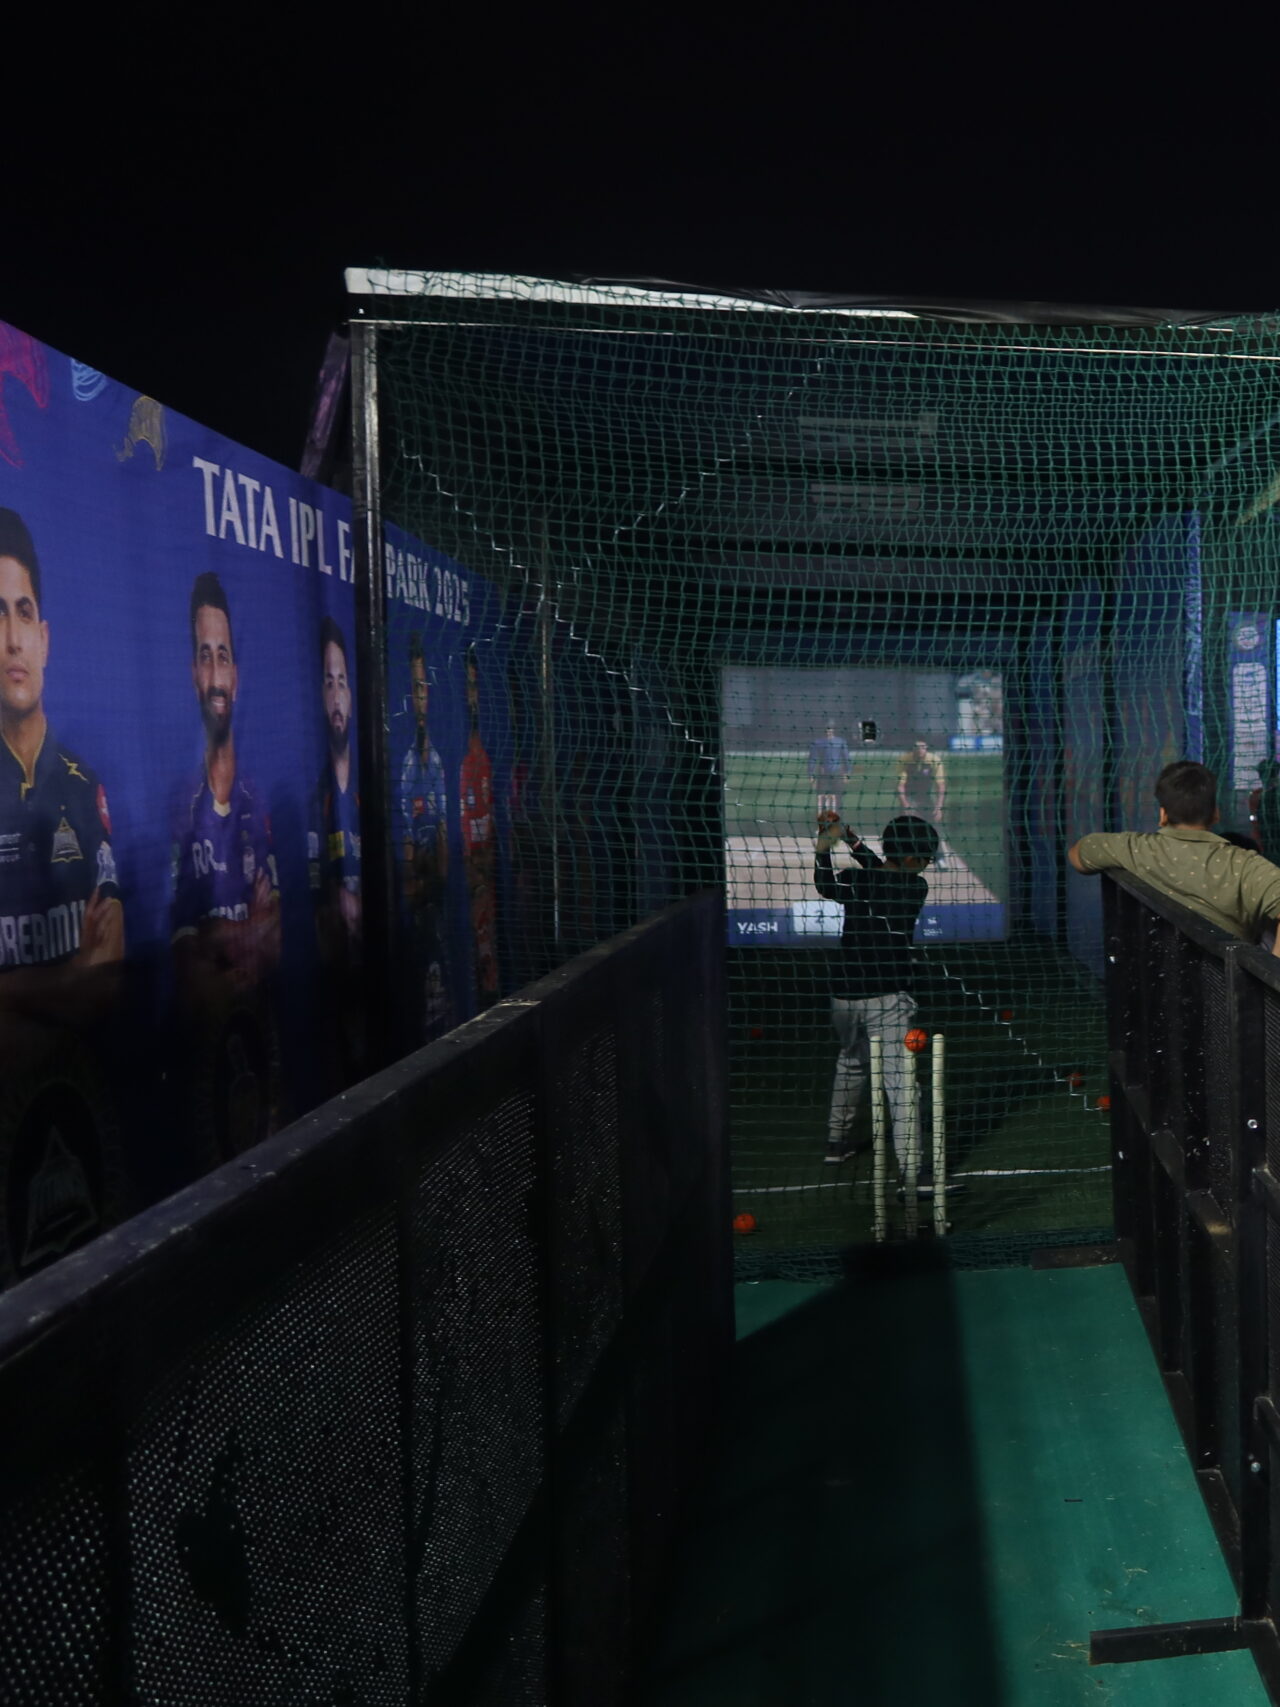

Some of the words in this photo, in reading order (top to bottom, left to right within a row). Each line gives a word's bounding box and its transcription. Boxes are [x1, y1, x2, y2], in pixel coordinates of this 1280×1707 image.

[193, 456, 284, 559] TATA
[288, 497, 333, 576] IPL
[385, 541, 432, 612] PARK
[433, 564, 471, 627] 2025
[737, 921, 779, 934] YASH
